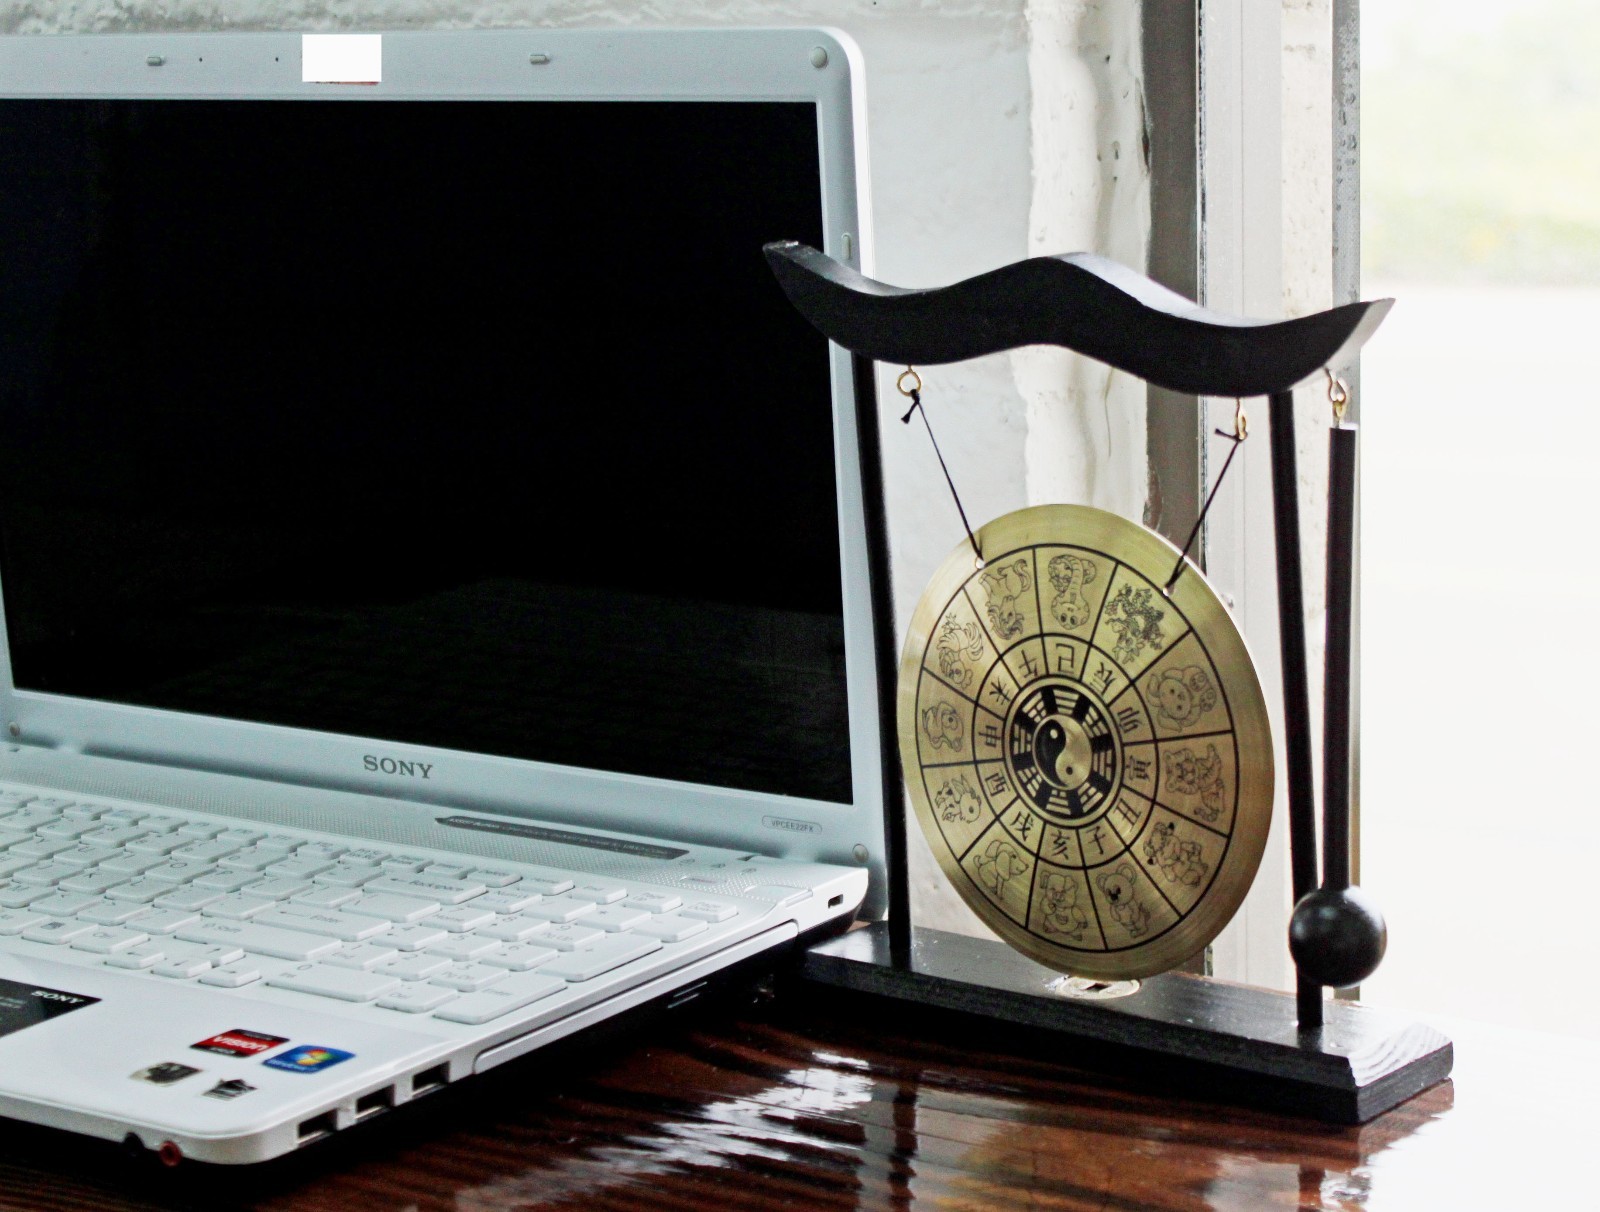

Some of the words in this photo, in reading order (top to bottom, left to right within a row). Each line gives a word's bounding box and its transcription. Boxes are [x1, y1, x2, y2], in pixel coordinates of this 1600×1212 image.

[1018, 649, 1038, 679] 午
[1089, 661, 1117, 695] 辰
[989, 676, 1012, 706] 未
[1116, 706, 1142, 734] 卯
[978, 725, 1001, 748] 申
[363, 754, 434, 779] SONY
[1125, 755, 1152, 781] 寅
[985, 770, 1011, 797] 酉
[1112, 798, 1142, 837] 丑
[1051, 829, 1071, 861] 亥
[1085, 826, 1107, 855] 子
[31, 990, 85, 1004] SONY
